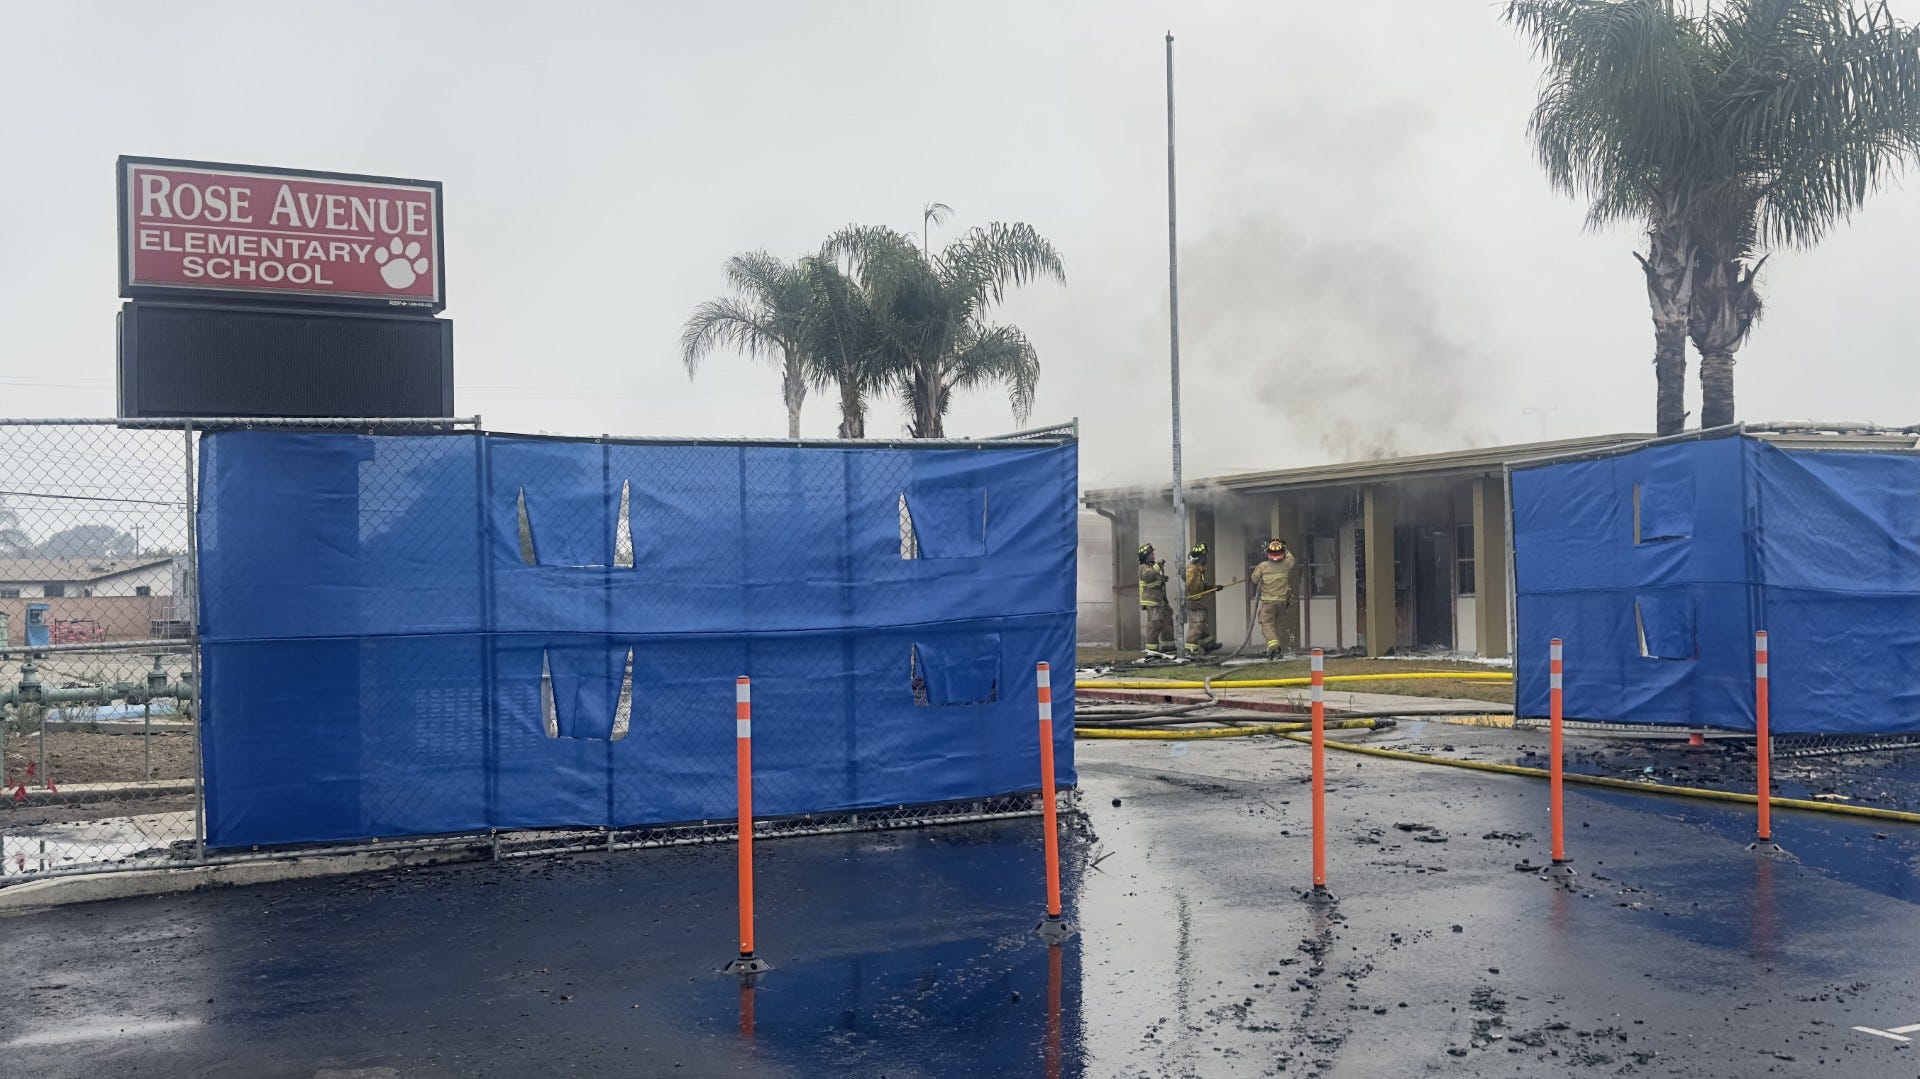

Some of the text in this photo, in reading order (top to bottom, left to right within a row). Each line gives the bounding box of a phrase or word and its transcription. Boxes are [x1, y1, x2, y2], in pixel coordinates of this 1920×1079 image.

[139, 173, 428, 236] ROSE AVENUE
[139, 229, 373, 264] ELEMENTARY
[182, 256, 334, 285] SCHOOL
